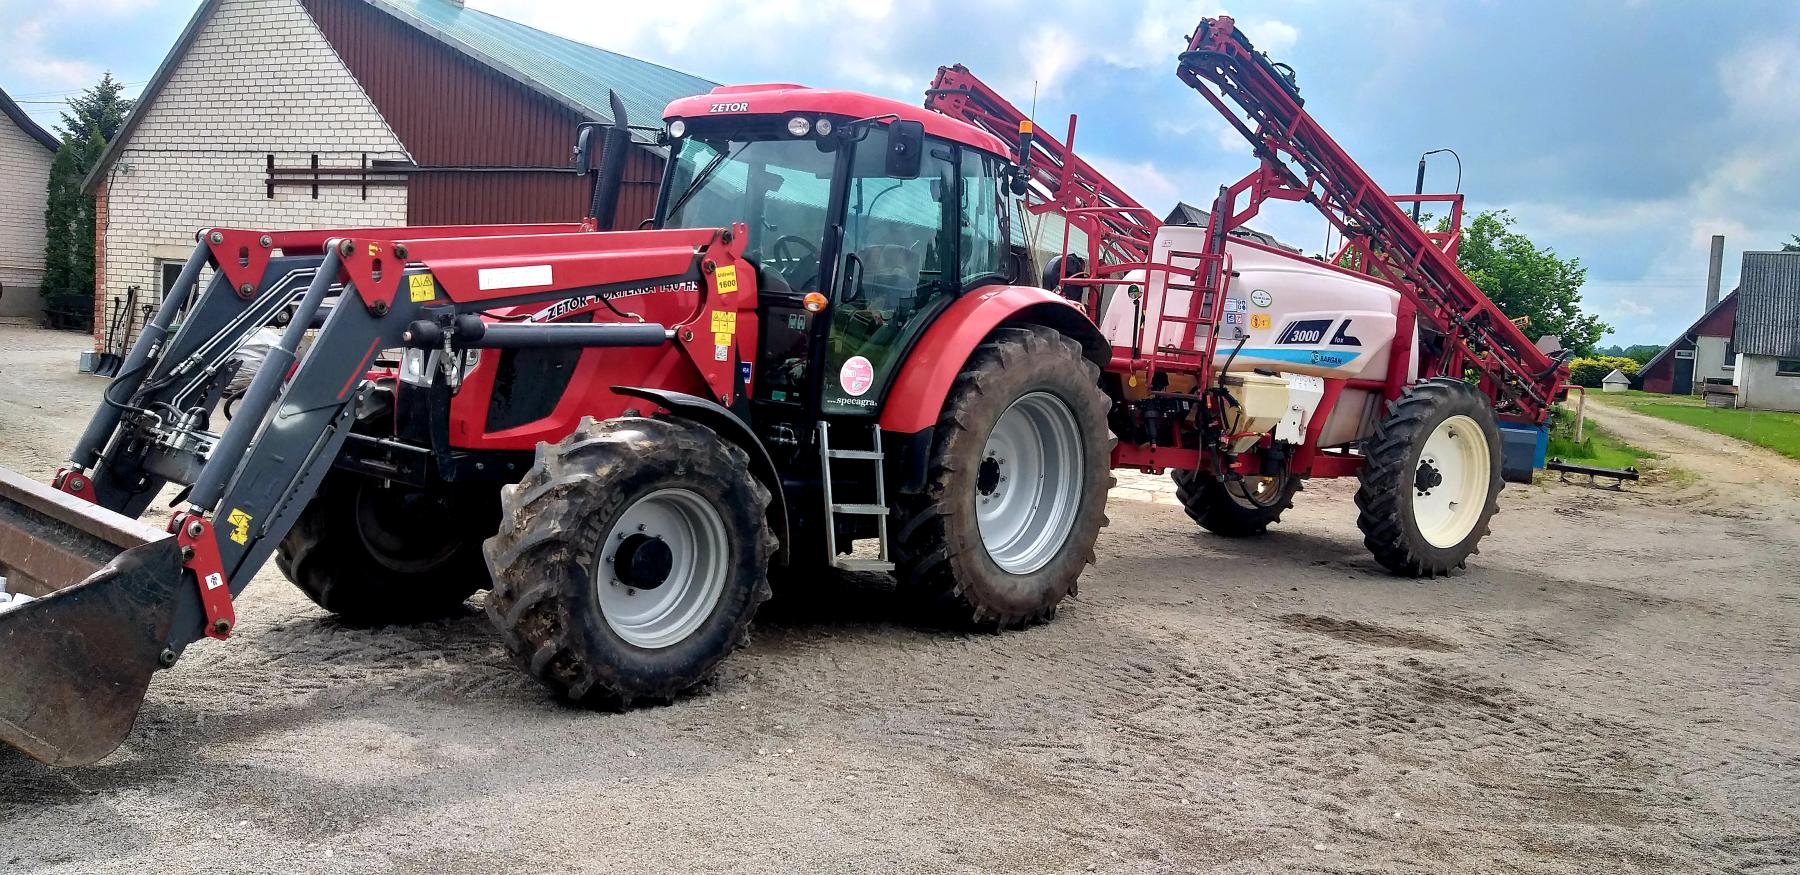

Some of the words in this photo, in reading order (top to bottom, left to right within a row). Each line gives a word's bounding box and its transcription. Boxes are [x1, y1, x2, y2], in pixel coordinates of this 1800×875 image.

[709, 102, 749, 113] ZETOR
[719, 279, 736, 289] 1600
[545, 296, 588, 322] ZETOR
[1291, 330, 1320, 342] 3000
